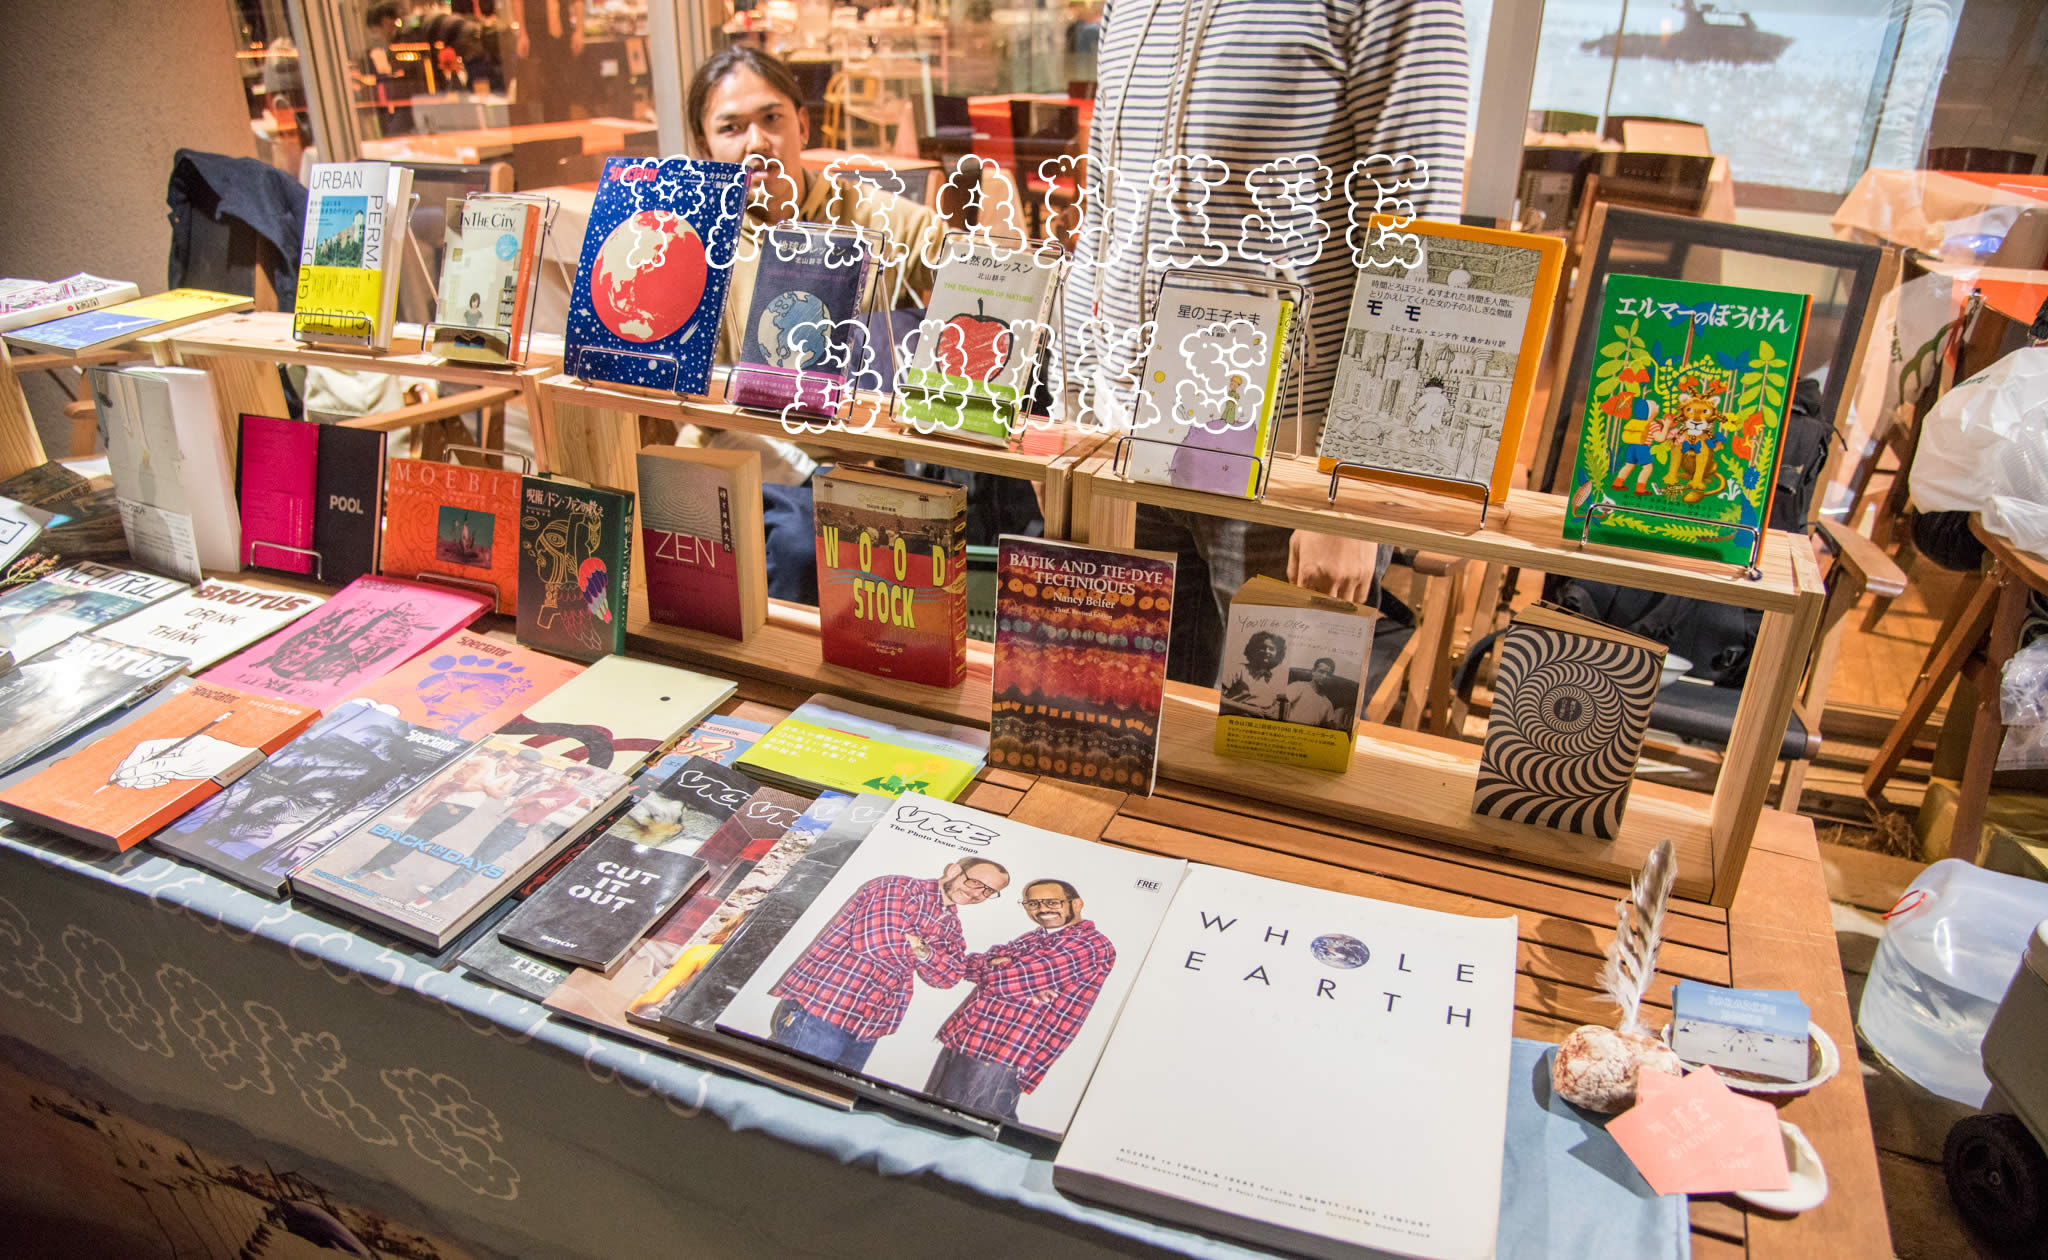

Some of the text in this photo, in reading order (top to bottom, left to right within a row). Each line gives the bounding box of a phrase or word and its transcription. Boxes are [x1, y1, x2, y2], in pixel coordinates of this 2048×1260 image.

[312, 169, 363, 190] URBAN
[1177, 304, 1261, 326] 星の王子さま
[1616, 296, 1792, 334] エルマーのぼうけん
[329, 494, 364, 515] POOL
[655, 529, 715, 568] ZEN
[823, 525, 946, 587] WOOD
[1009, 553, 1055, 571] BATIK
[1060, 560, 1096, 576] AND
[57, 563, 169, 599] NEUTRAL
[1034, 571, 1136, 596] TECHNIQUES
[192, 585, 310, 612] BRUTUS
[853, 577, 915, 629] STOCK
[1053, 591, 1116, 609] Nancy Belfer
[184, 607, 245, 626] DRINK
[187, 620, 202, 630] &
[149, 624, 207, 645] THINK
[457, 636, 512, 657] Spectator
[896, 805, 1000, 848] VICE
[368, 823, 433, 852] BACK
[444, 847, 505, 880] DAYS
[890, 824, 979, 856] The Photo Issue 2009
[594, 876, 631, 894] IT
[596, 861, 661, 886] CUT
[1137, 879, 1160, 891] FREE
[568, 884, 636, 912] OUT
[510, 955, 561, 983] THE
[1184, 949, 1472, 1028] EARTH
